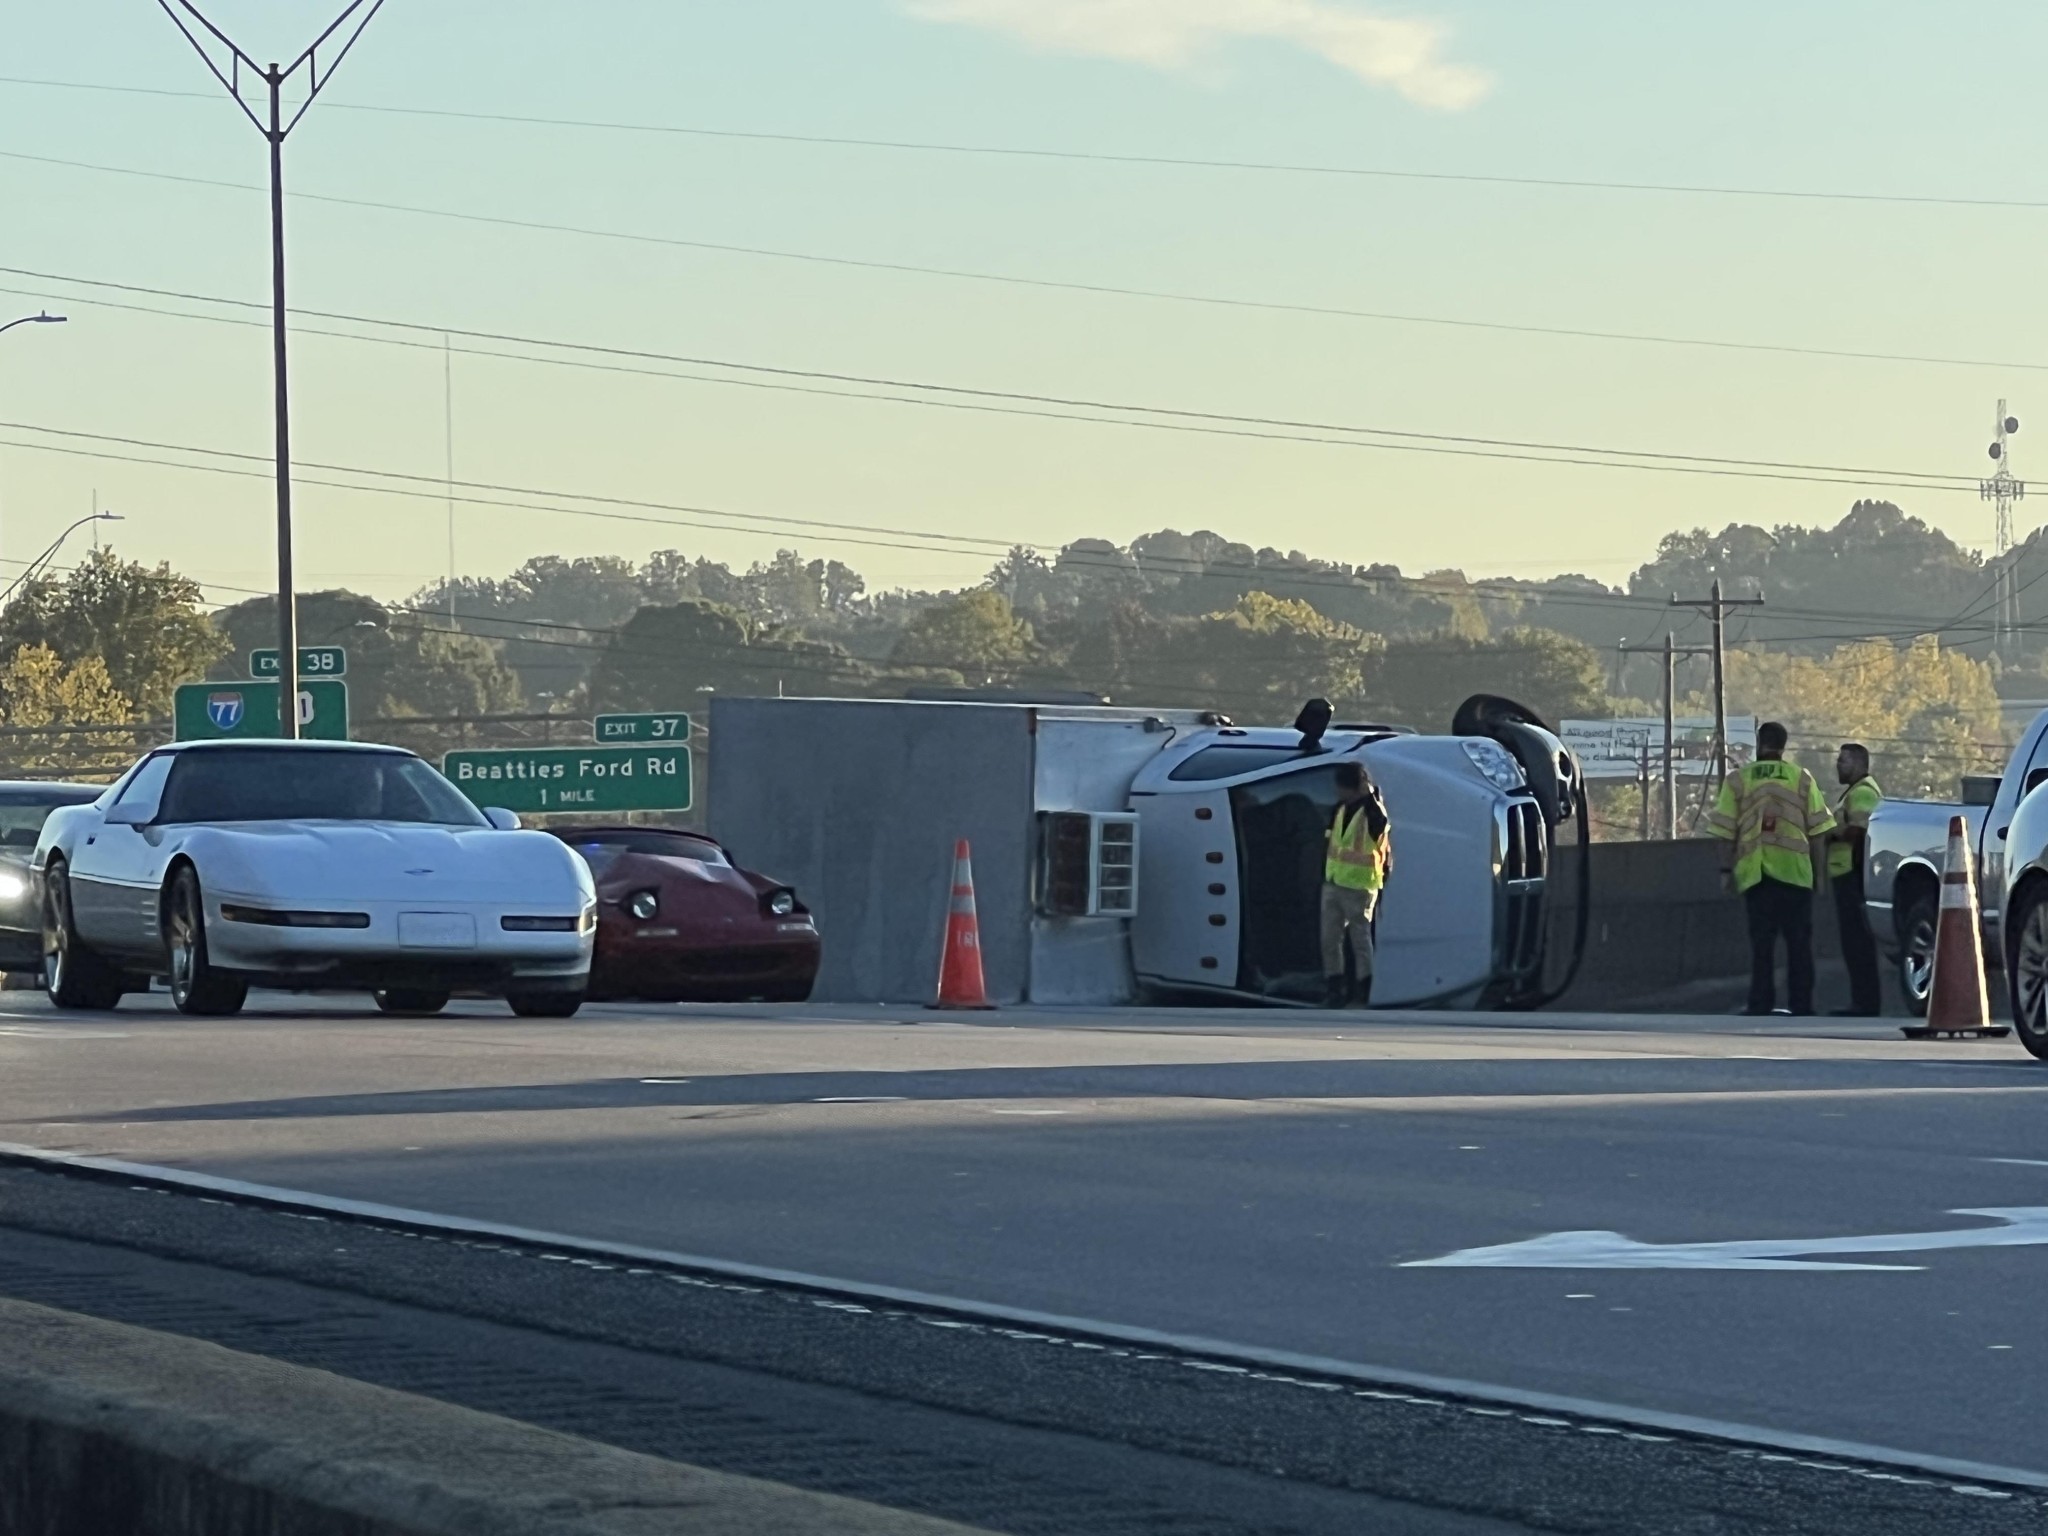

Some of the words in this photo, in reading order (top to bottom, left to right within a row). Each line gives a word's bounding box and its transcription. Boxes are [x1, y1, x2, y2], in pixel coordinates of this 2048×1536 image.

[307, 653, 334, 671] 38
[212, 701, 239, 722] 77
[604, 722, 637, 736] EXIT
[651, 719, 679, 737] 37
[458, 760, 565, 780] Beatties
[579, 758, 633, 778] Ford
[647, 757, 676, 775] Rd
[540, 788, 547, 805] 1
[560, 789, 596, 802] MILE
